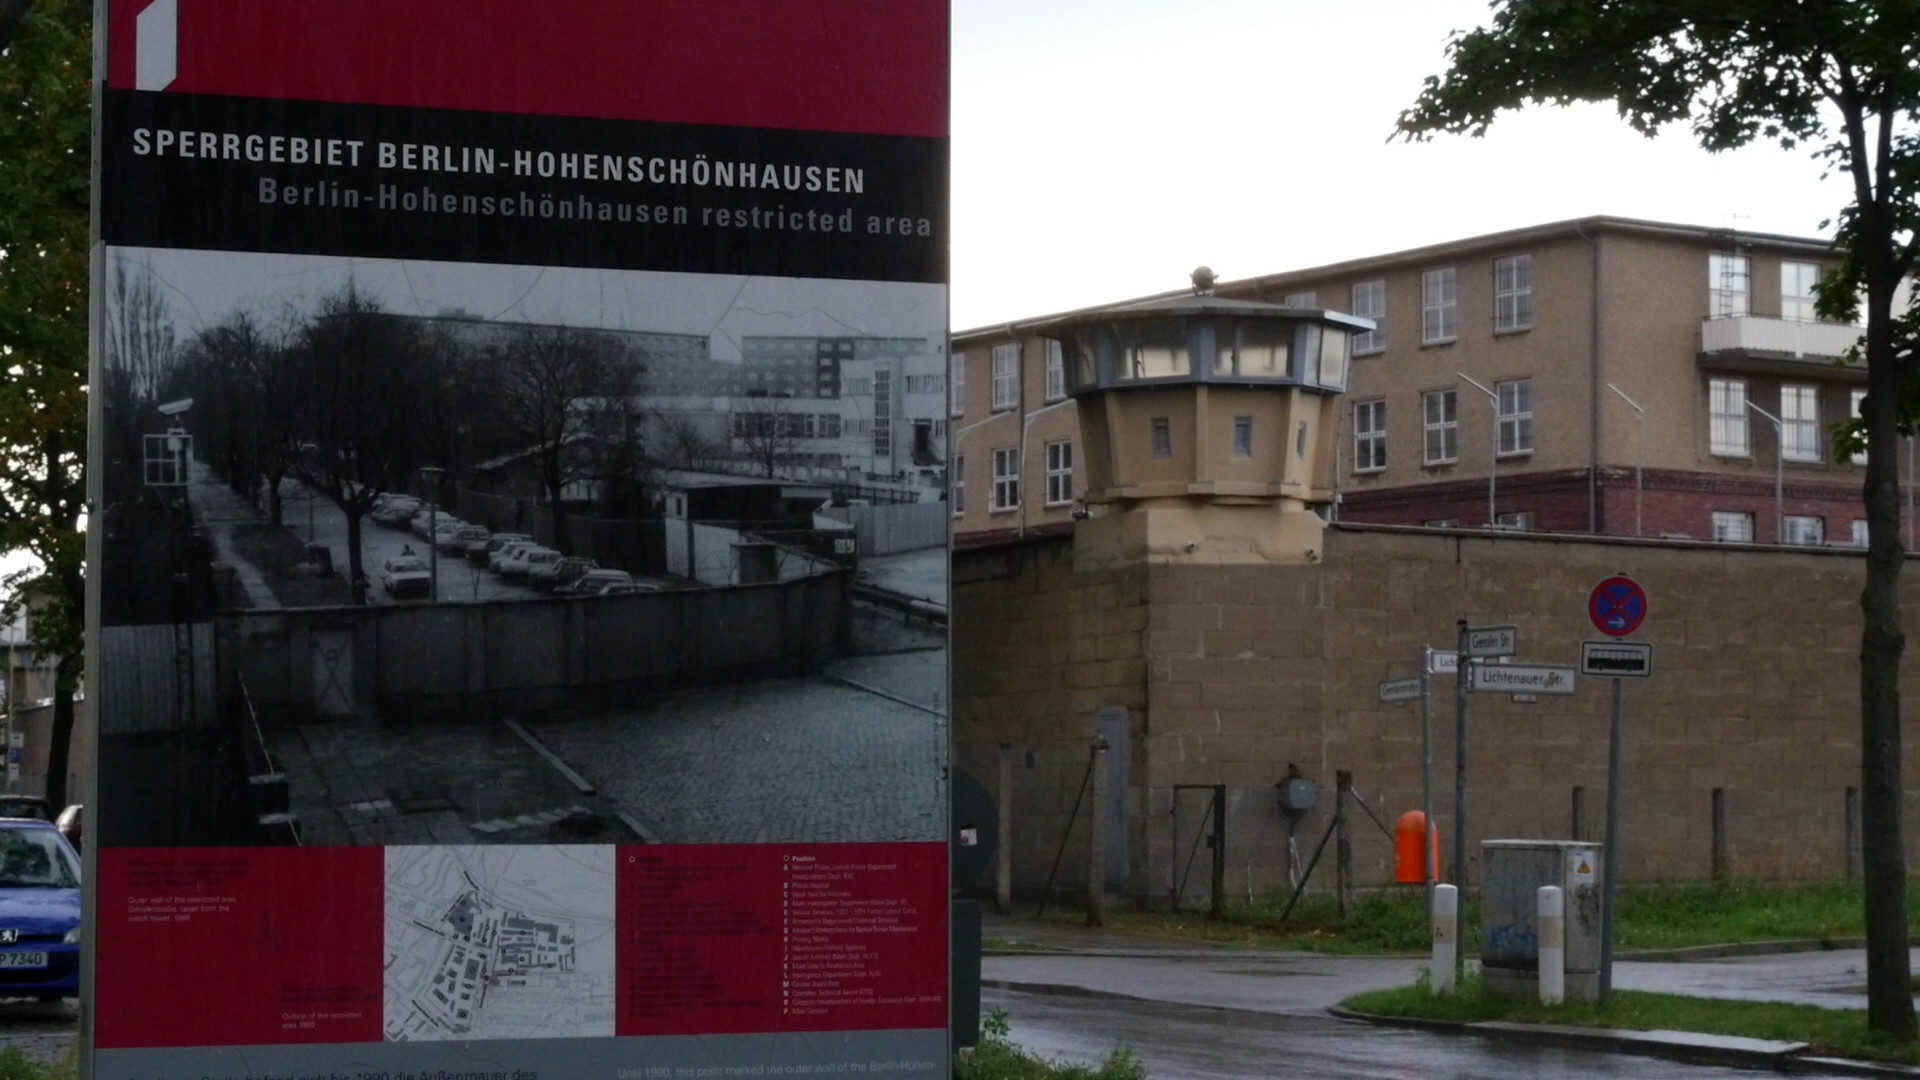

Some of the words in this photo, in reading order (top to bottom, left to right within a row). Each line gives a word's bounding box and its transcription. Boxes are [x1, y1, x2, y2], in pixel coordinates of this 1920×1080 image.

[133, 127, 364, 167] SPERRGEBIET
[378, 142, 864, 194] BERLIN-HOHENSCHÖNHAUSEN
[259, 177, 688, 225] Berlin-Hohenschönhausen
[702, 204, 852, 233] restricted
[867, 212, 931, 237] area
[1483, 669, 1544, 685] Lichtenauer
[10, 952, 42, 965] 7340
[512, 1067, 537, 1080] des
[618, 1068, 642, 1079] Until
[675, 1067, 695, 1077] this
[697, 1066, 723, 1078] point
[725, 1064, 764, 1075] marked
[767, 1064, 783, 1074] the
[785, 1064, 812, 1074] outer
[815, 1063, 835, 1073] wall
[836, 1062, 848, 1072] of
[850, 1061, 867, 1072] the
